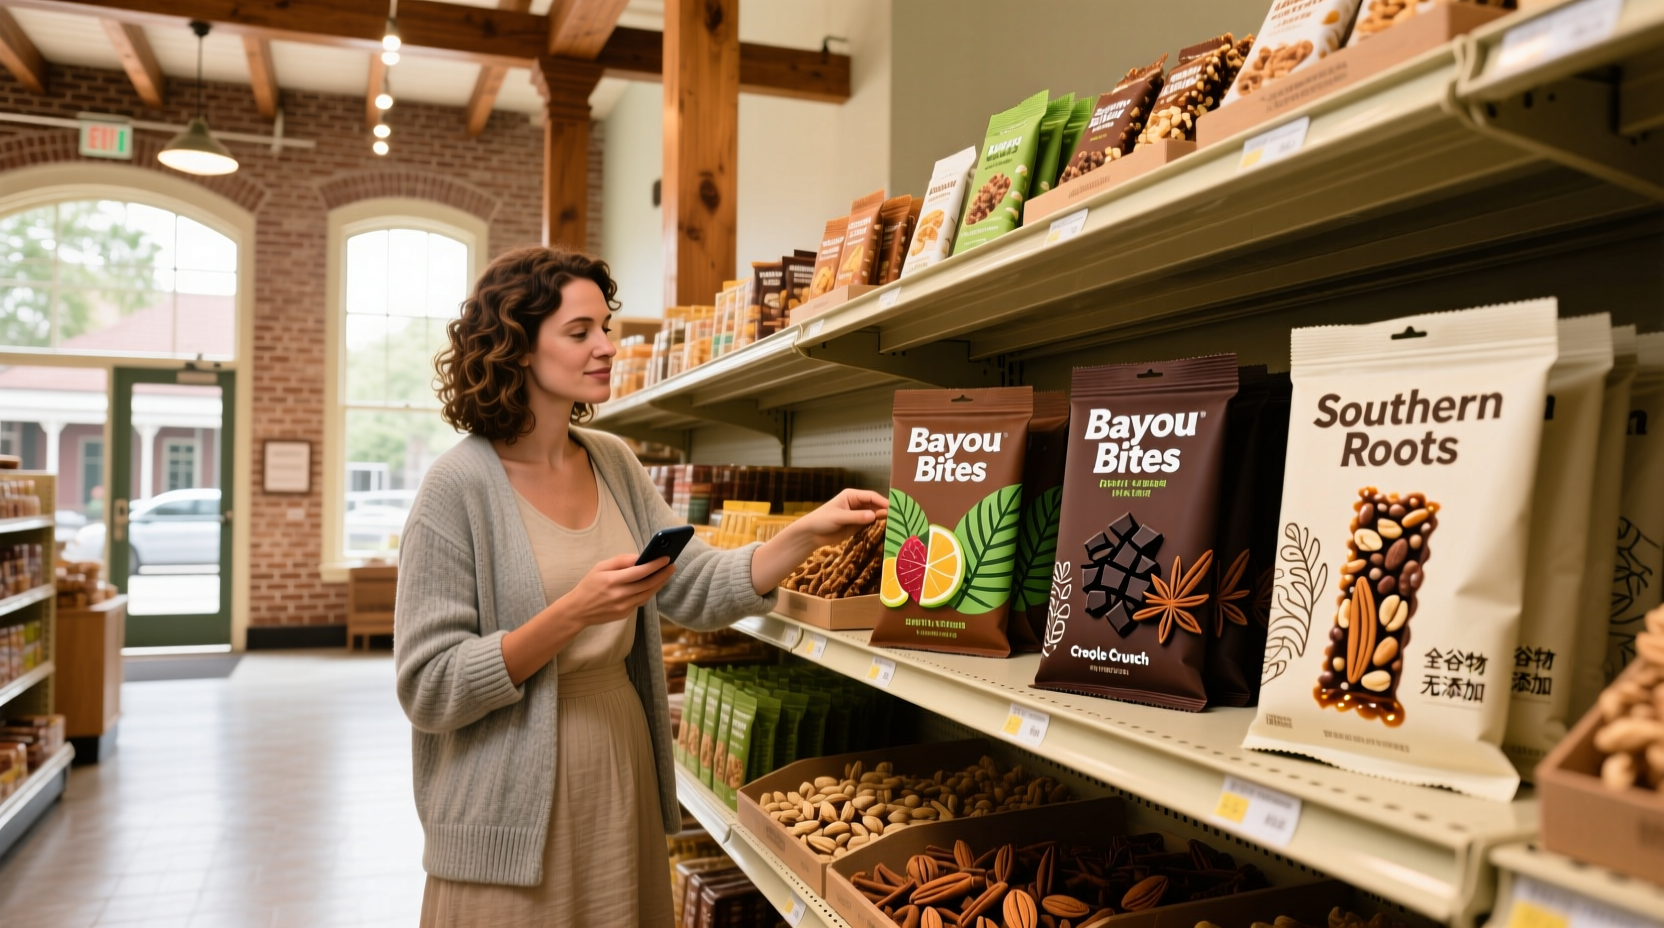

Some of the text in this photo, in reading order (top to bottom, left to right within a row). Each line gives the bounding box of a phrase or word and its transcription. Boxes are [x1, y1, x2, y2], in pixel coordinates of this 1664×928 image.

[1313, 389, 1503, 429] Southern
[1084, 407, 1200, 446] Bayou
[906, 427, 1002, 459] Bayou
[1093, 440, 1181, 474] Bites
[1341, 430, 1459, 467] Roots
[914, 455, 987, 483] Bites
[1424, 647, 1489, 676] 全谷物
[1513, 646, 1557, 670] 谷物
[1420, 674, 1486, 703] 无添加
[1511, 671, 1553, 695] 添加
